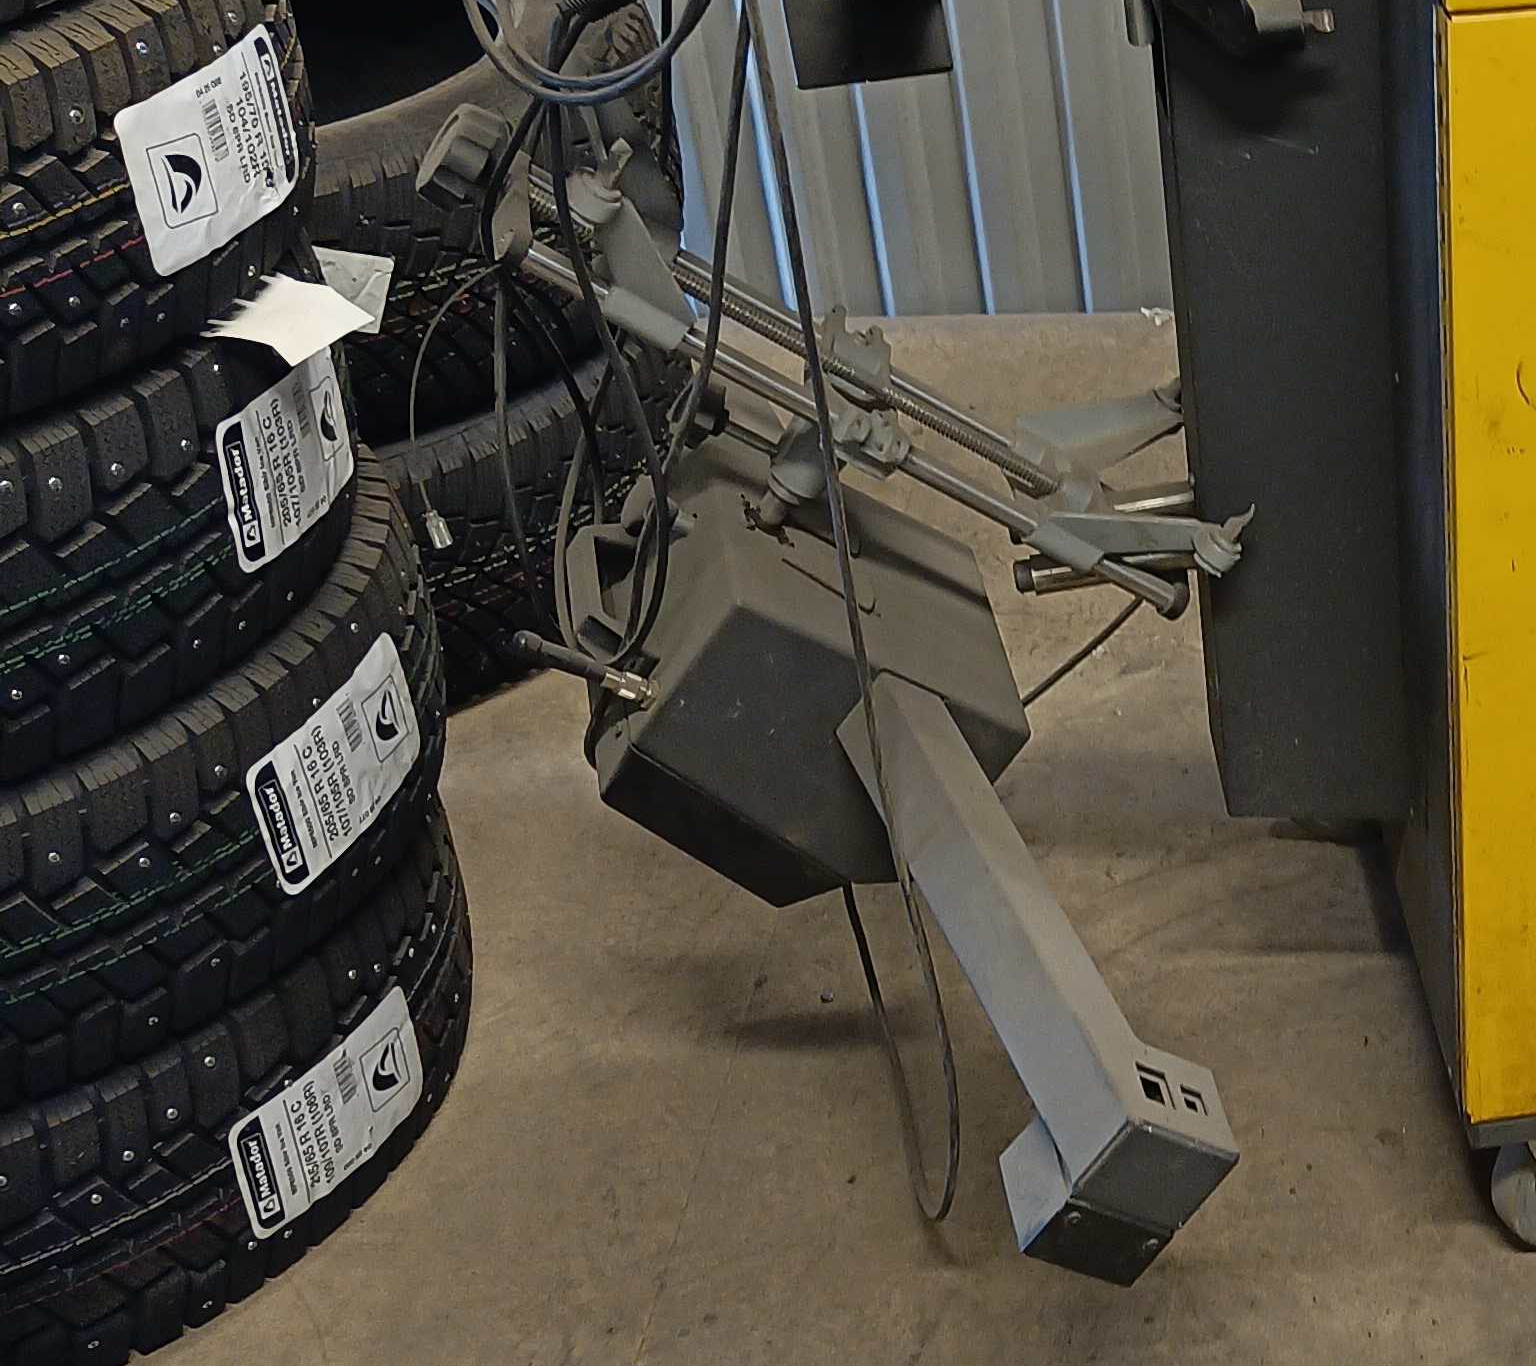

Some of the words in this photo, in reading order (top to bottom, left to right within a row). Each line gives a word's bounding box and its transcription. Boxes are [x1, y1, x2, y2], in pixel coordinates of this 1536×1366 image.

[261, 415, 272, 429] C
[271, 455, 281, 470] R
[228, 448, 254, 521] Matador
[274, 471, 292, 527] 205/65
[301, 745, 314, 759] C
[306, 759, 320, 779] 16
[309, 724, 334, 772] (103R)
[312, 778, 325, 794] R
[326, 771, 353, 836] 107/105R
[262, 786, 293, 850] Matador
[317, 794, 339, 841] 205/65
[289, 1099, 302, 1113] C
[293, 1112, 307, 1130] 16
[298, 1130, 311, 1145] R
[312, 1123, 336, 1183] 109/107R
[246, 1138, 271, 1198] Matador
[301, 1144, 321, 1187] 215/65
